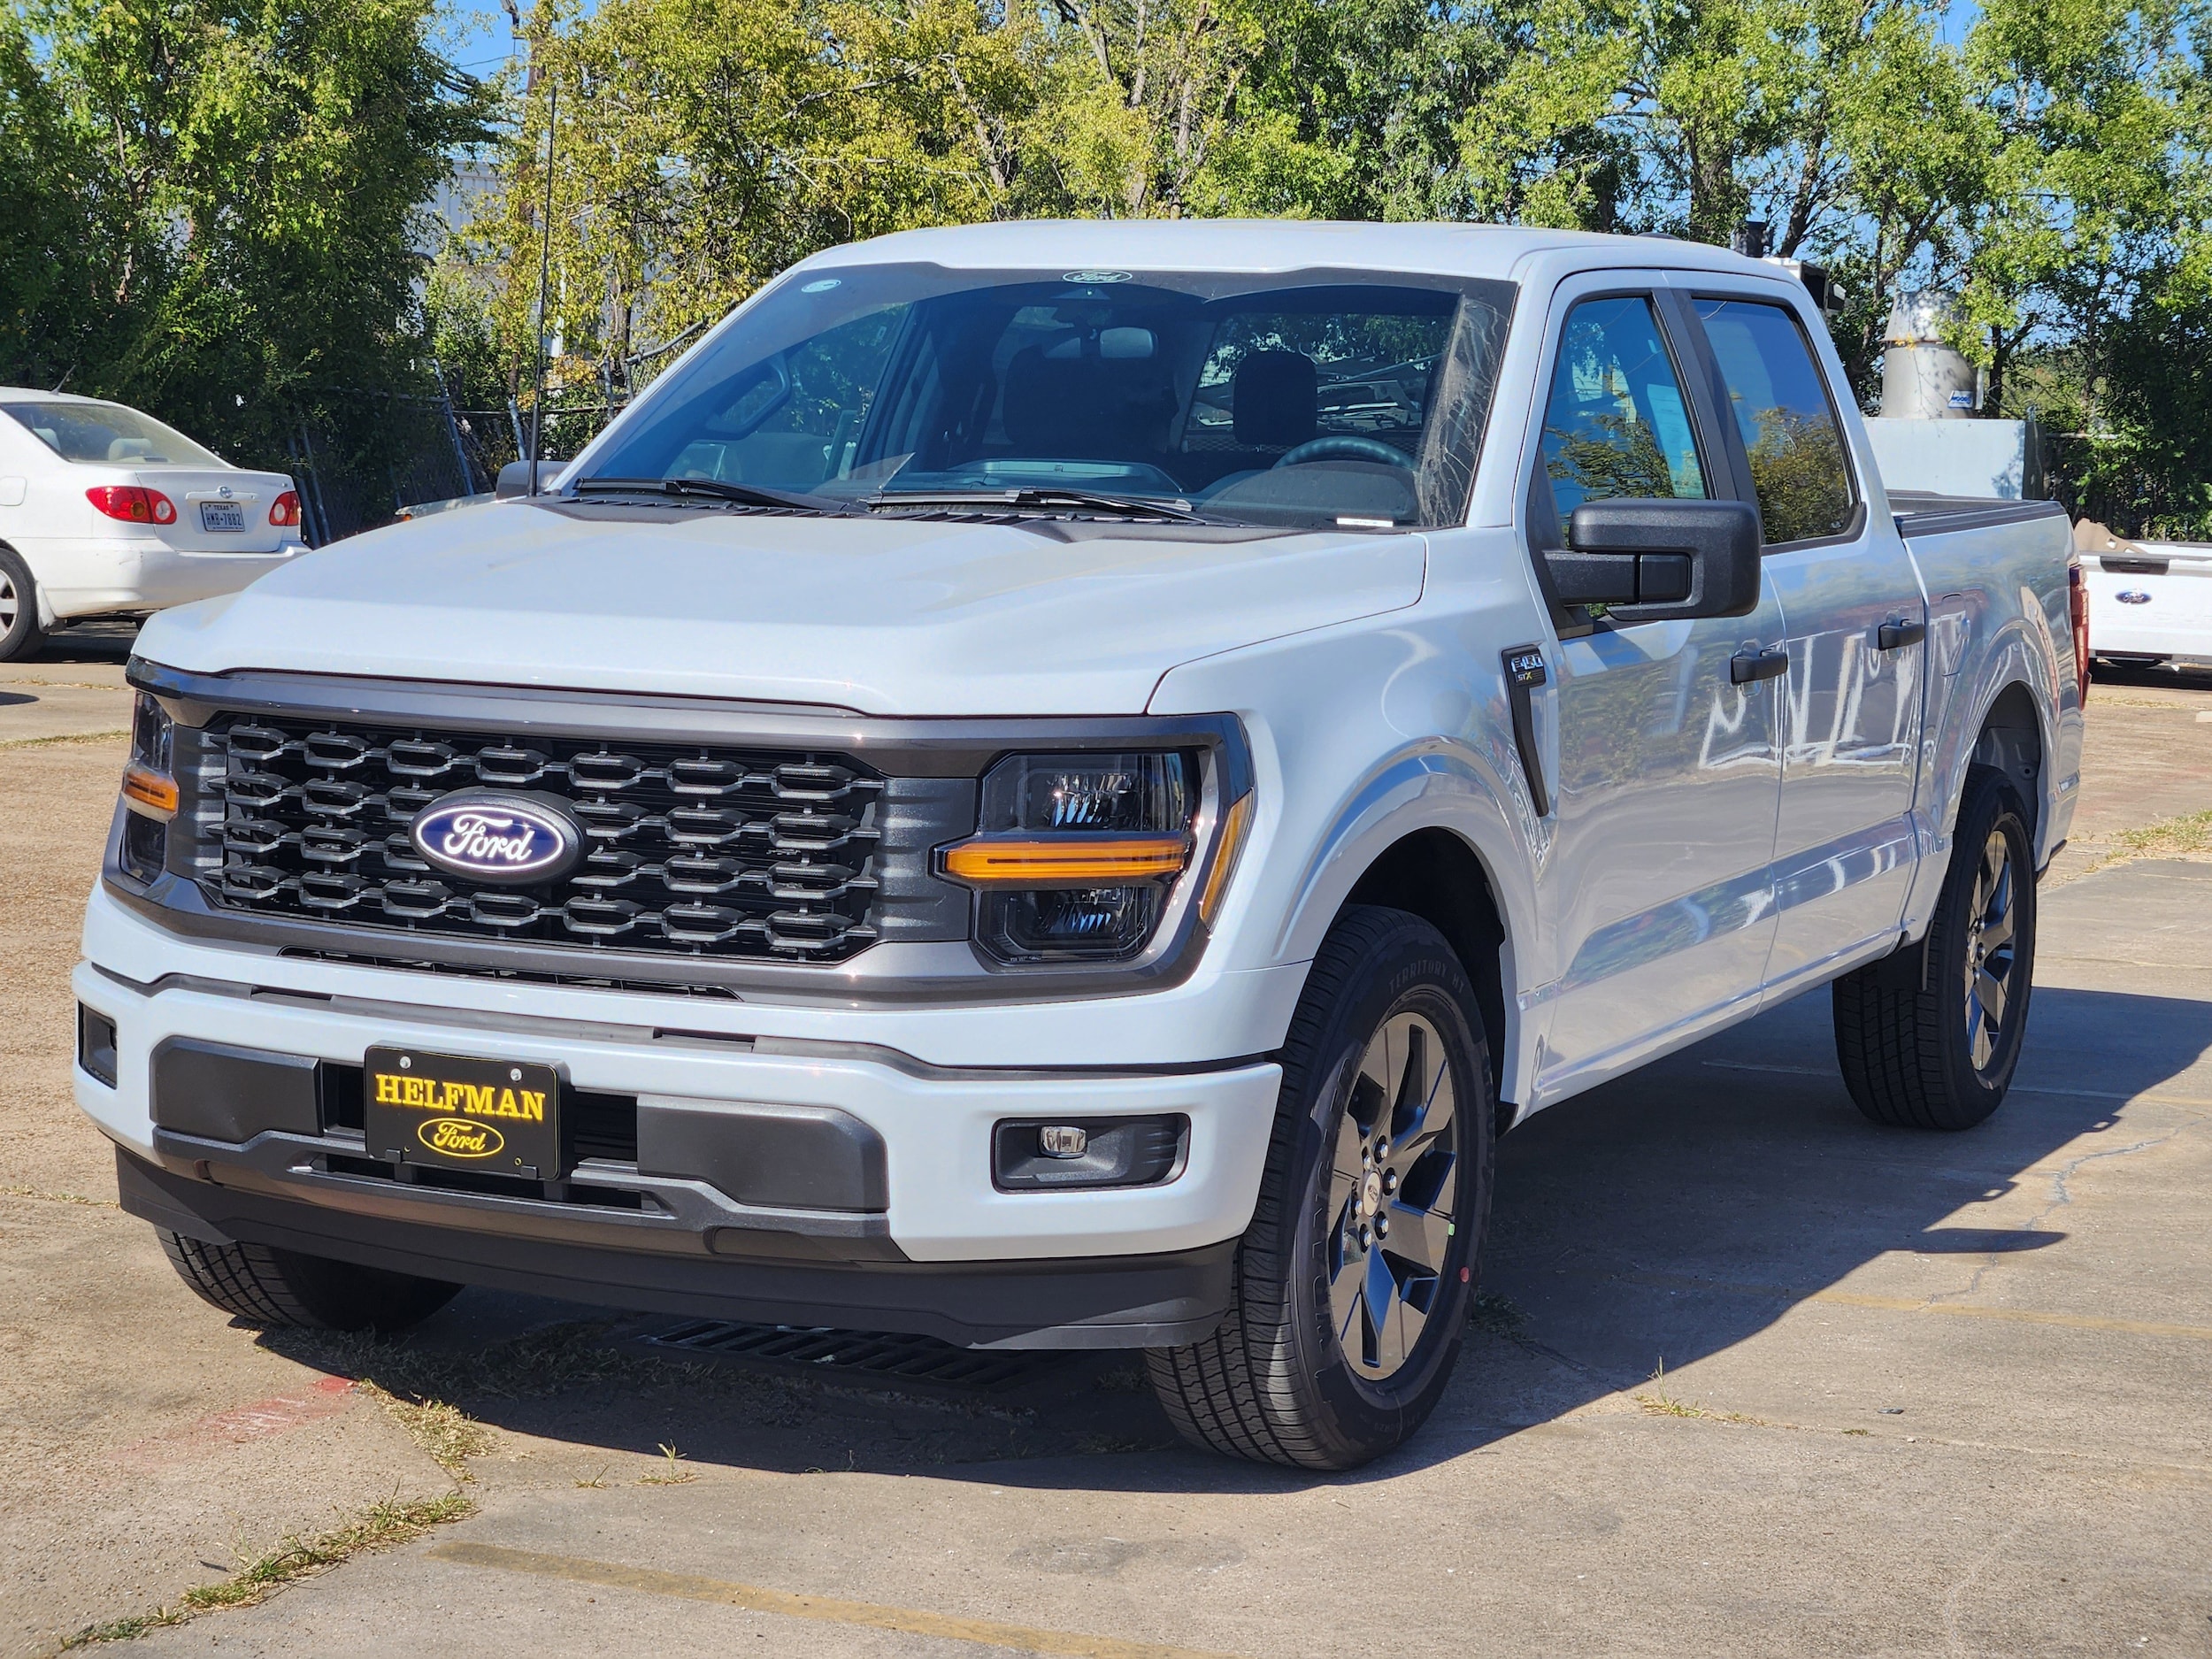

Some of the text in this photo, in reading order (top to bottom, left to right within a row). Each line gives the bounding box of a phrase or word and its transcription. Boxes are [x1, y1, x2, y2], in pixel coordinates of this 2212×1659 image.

[1072, 271, 1122, 281] Ford
[1517, 671, 1533, 681] STX
[443, 813, 536, 862] Ford
[1388, 959, 1448, 995] TERRITORY
[374, 1073, 546, 1122] HELFMAN
[433, 1121, 487, 1151] Ford
